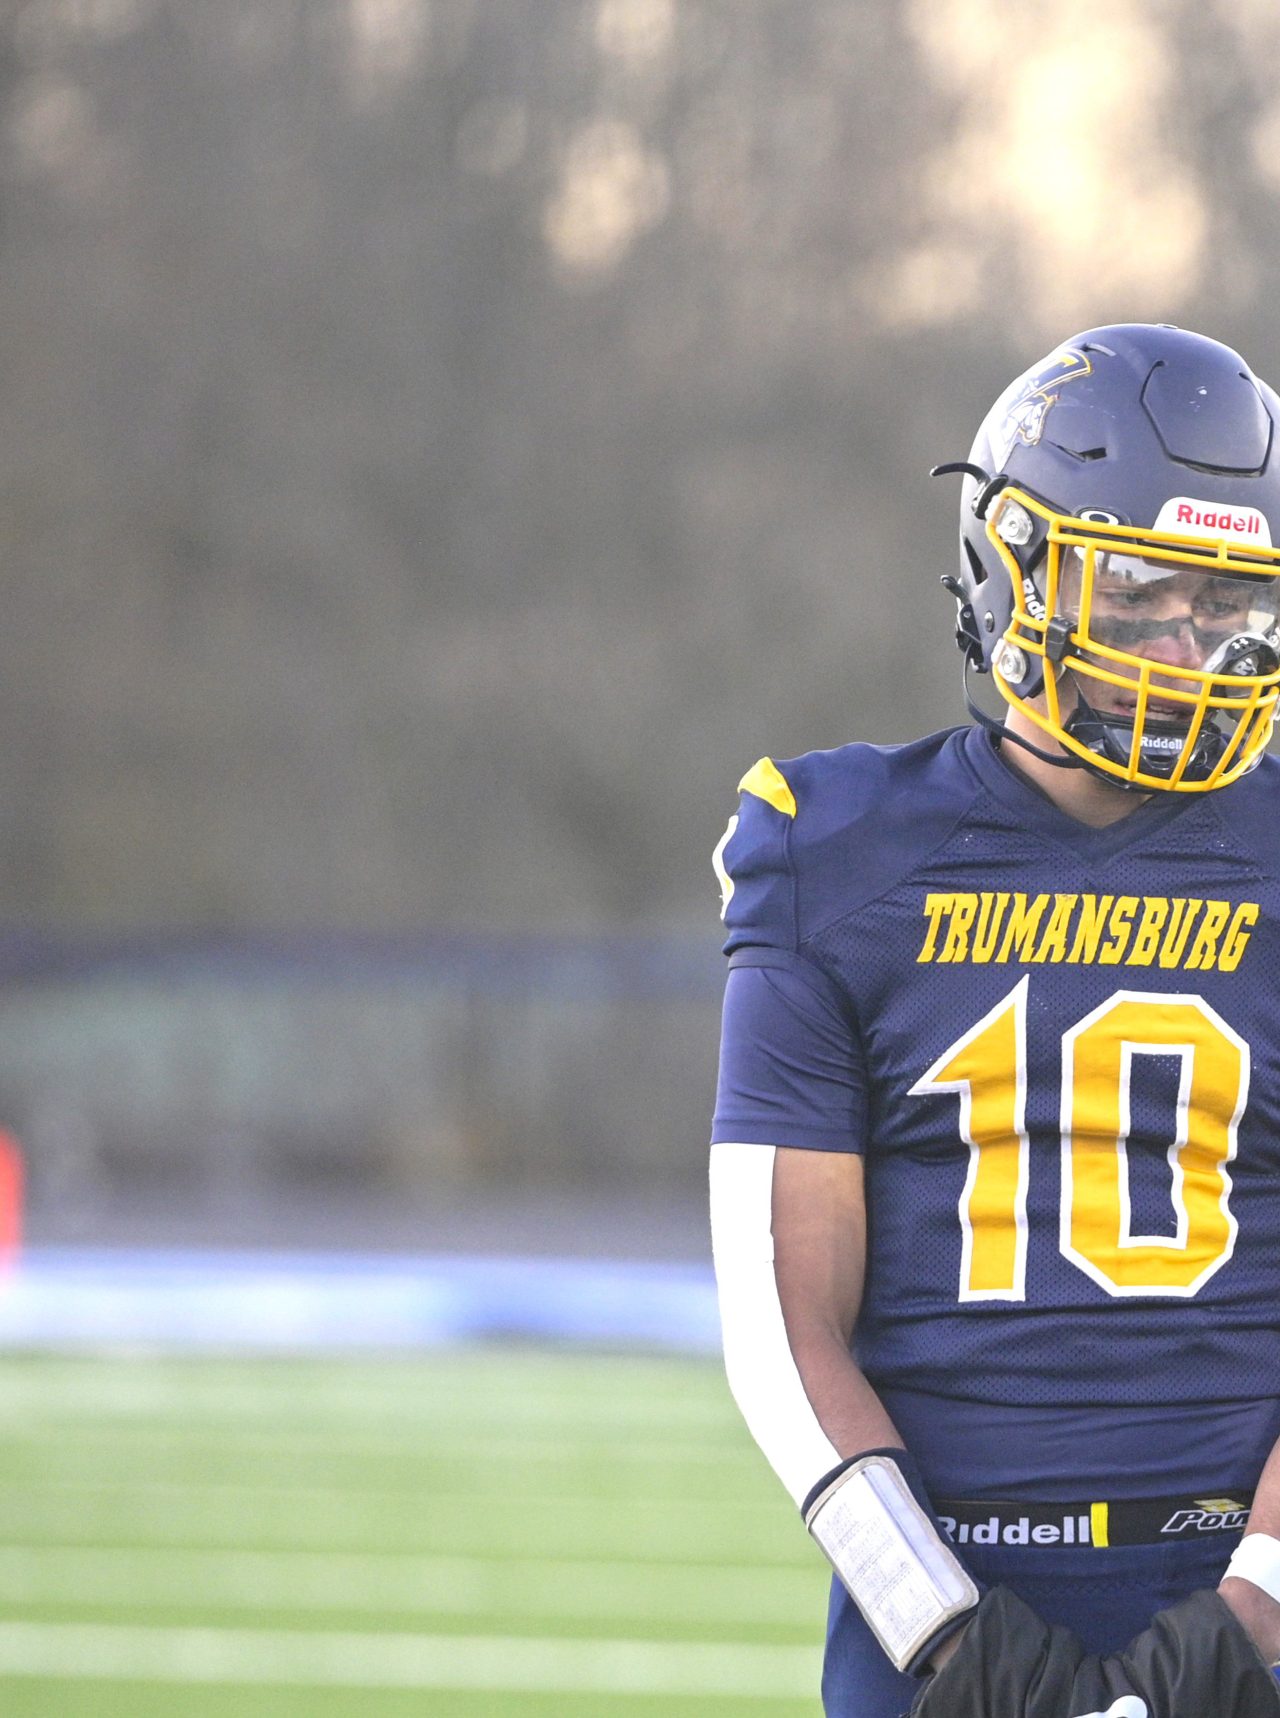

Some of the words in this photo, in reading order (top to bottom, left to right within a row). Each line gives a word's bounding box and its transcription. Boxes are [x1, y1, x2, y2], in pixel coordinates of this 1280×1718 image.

[1177, 504, 1260, 534] Riddell
[1140, 736, 1183, 750] Riddell
[917, 892, 1259, 971] TRUMANSBURG
[907, 973, 1251, 1302] 10
